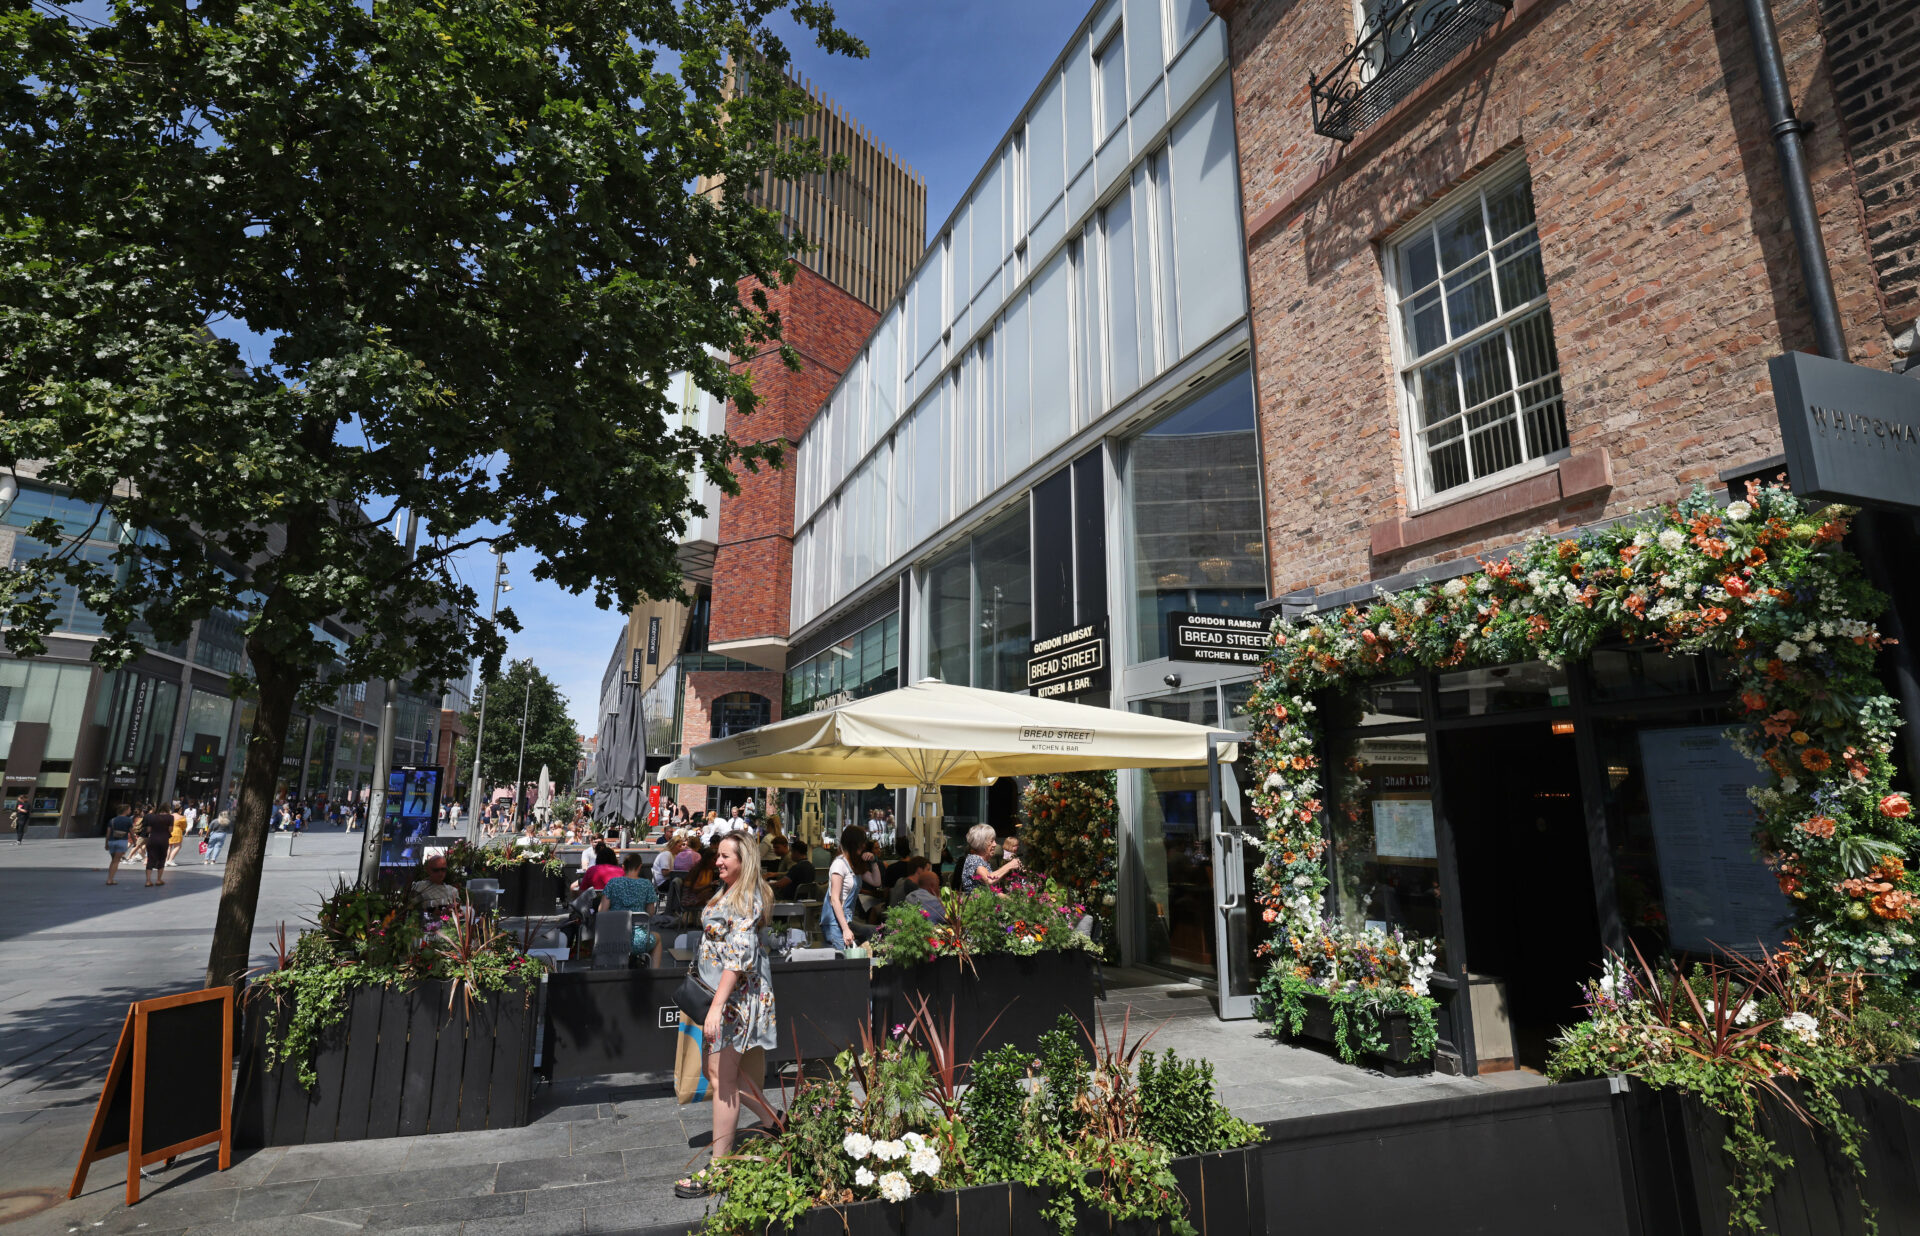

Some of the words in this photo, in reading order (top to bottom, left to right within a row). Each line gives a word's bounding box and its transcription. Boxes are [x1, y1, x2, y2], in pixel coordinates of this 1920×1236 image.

[1810, 405, 1920, 444] WHITEWA
[1188, 616, 1225, 626] GORDON
[1228, 619, 1262, 629] RAMSAY
[1034, 636, 1061, 653] GORDON
[1063, 625, 1093, 644] RAMSAY
[1185, 631, 1222, 643] BREAD
[1227, 634, 1267, 647] STREET
[1031, 659, 1059, 679] BREAD
[1061, 647, 1097, 670] STREET
[1195, 650, 1231, 660] KITCHEN
[1234, 652, 1240, 660] &
[1242, 653, 1260, 661] BAR
[1038, 683, 1065, 698] KITCHEN
[1067, 681, 1073, 691] &
[1074, 677, 1090, 690] BAR
[128, 682, 146, 758] GOLDSMITHS
[1024, 729, 1054, 738] BREAD
[1057, 731, 1090, 740] STREET
